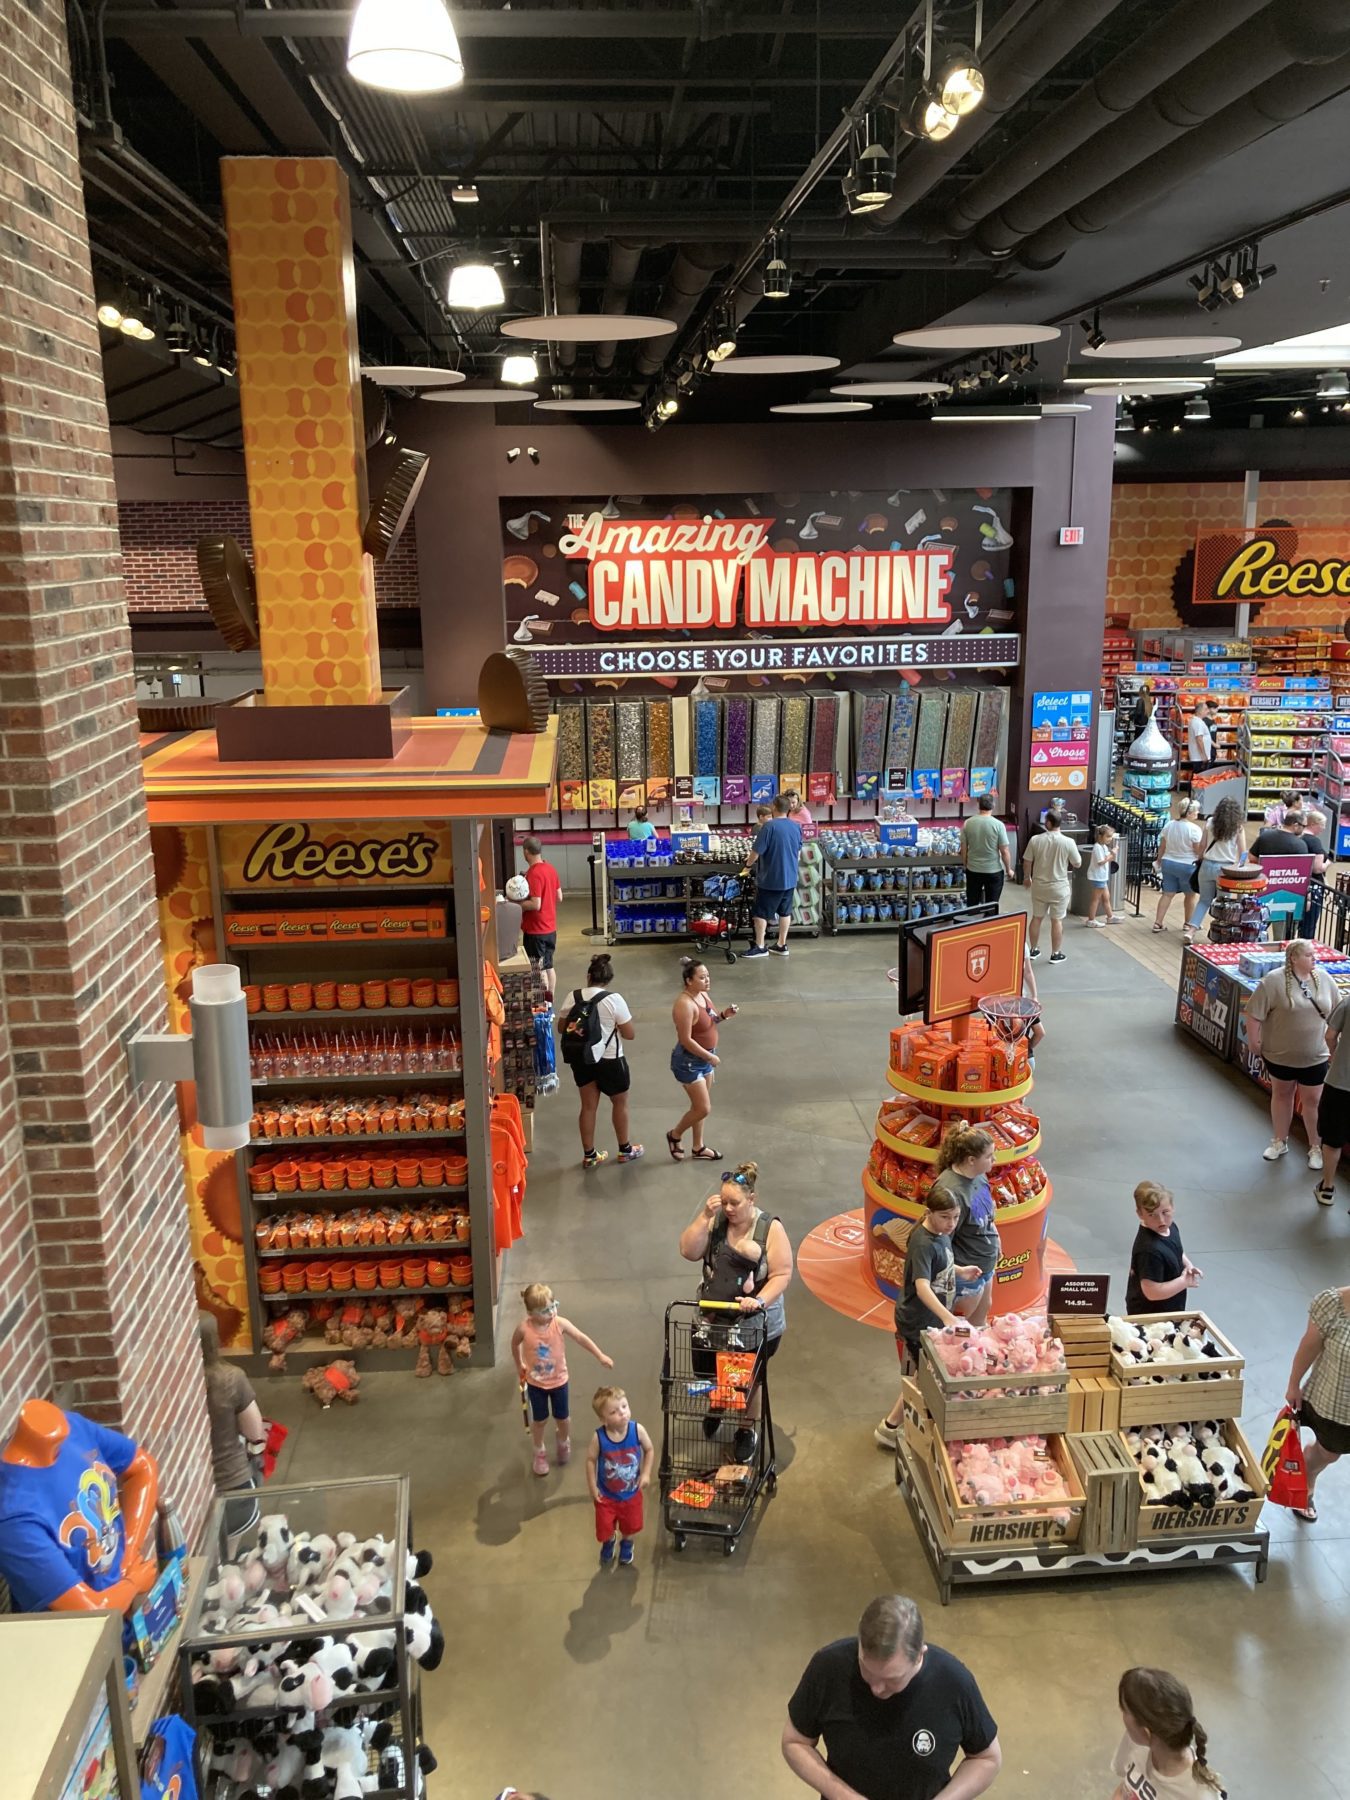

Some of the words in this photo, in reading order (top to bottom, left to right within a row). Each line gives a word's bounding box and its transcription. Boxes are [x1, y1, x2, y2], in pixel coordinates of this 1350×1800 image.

[567, 514, 584, 529] THE
[559, 512, 769, 566] Amazing
[1064, 529, 1081, 543] EXIT
[593, 557, 738, 626] CANDY
[750, 554, 949, 622] MACHINE
[600, 649, 705, 671] CHOOSE
[713, 647, 783, 668] YOUR
[794, 643, 928, 667] FAVORITES
[1037, 695, 1068, 708] Select
[1251, 696, 1280, 706] HERSHEY'S
[1037, 752, 1043, 760] 2
[1049, 746, 1086, 758] Choose
[1032, 771, 1061, 786] Enjoy
[247, 823, 435, 878] Reese's
[1268, 868, 1300, 877] RETAIL
[1267, 876, 1307, 885] HECKOUT
[228, 921, 259, 932] Reese's
[279, 920, 310, 931] Reese's
[330, 918, 361, 929] Reese's
[380, 917, 411, 929] Reese's
[1191, 1010, 1225, 1050] HERSHEY'S
[960, 1082, 982, 1090] Reese's
[1010, 1272, 1023, 1280] CUP
[1151, 1506, 1250, 1530] HERSHEY'S
